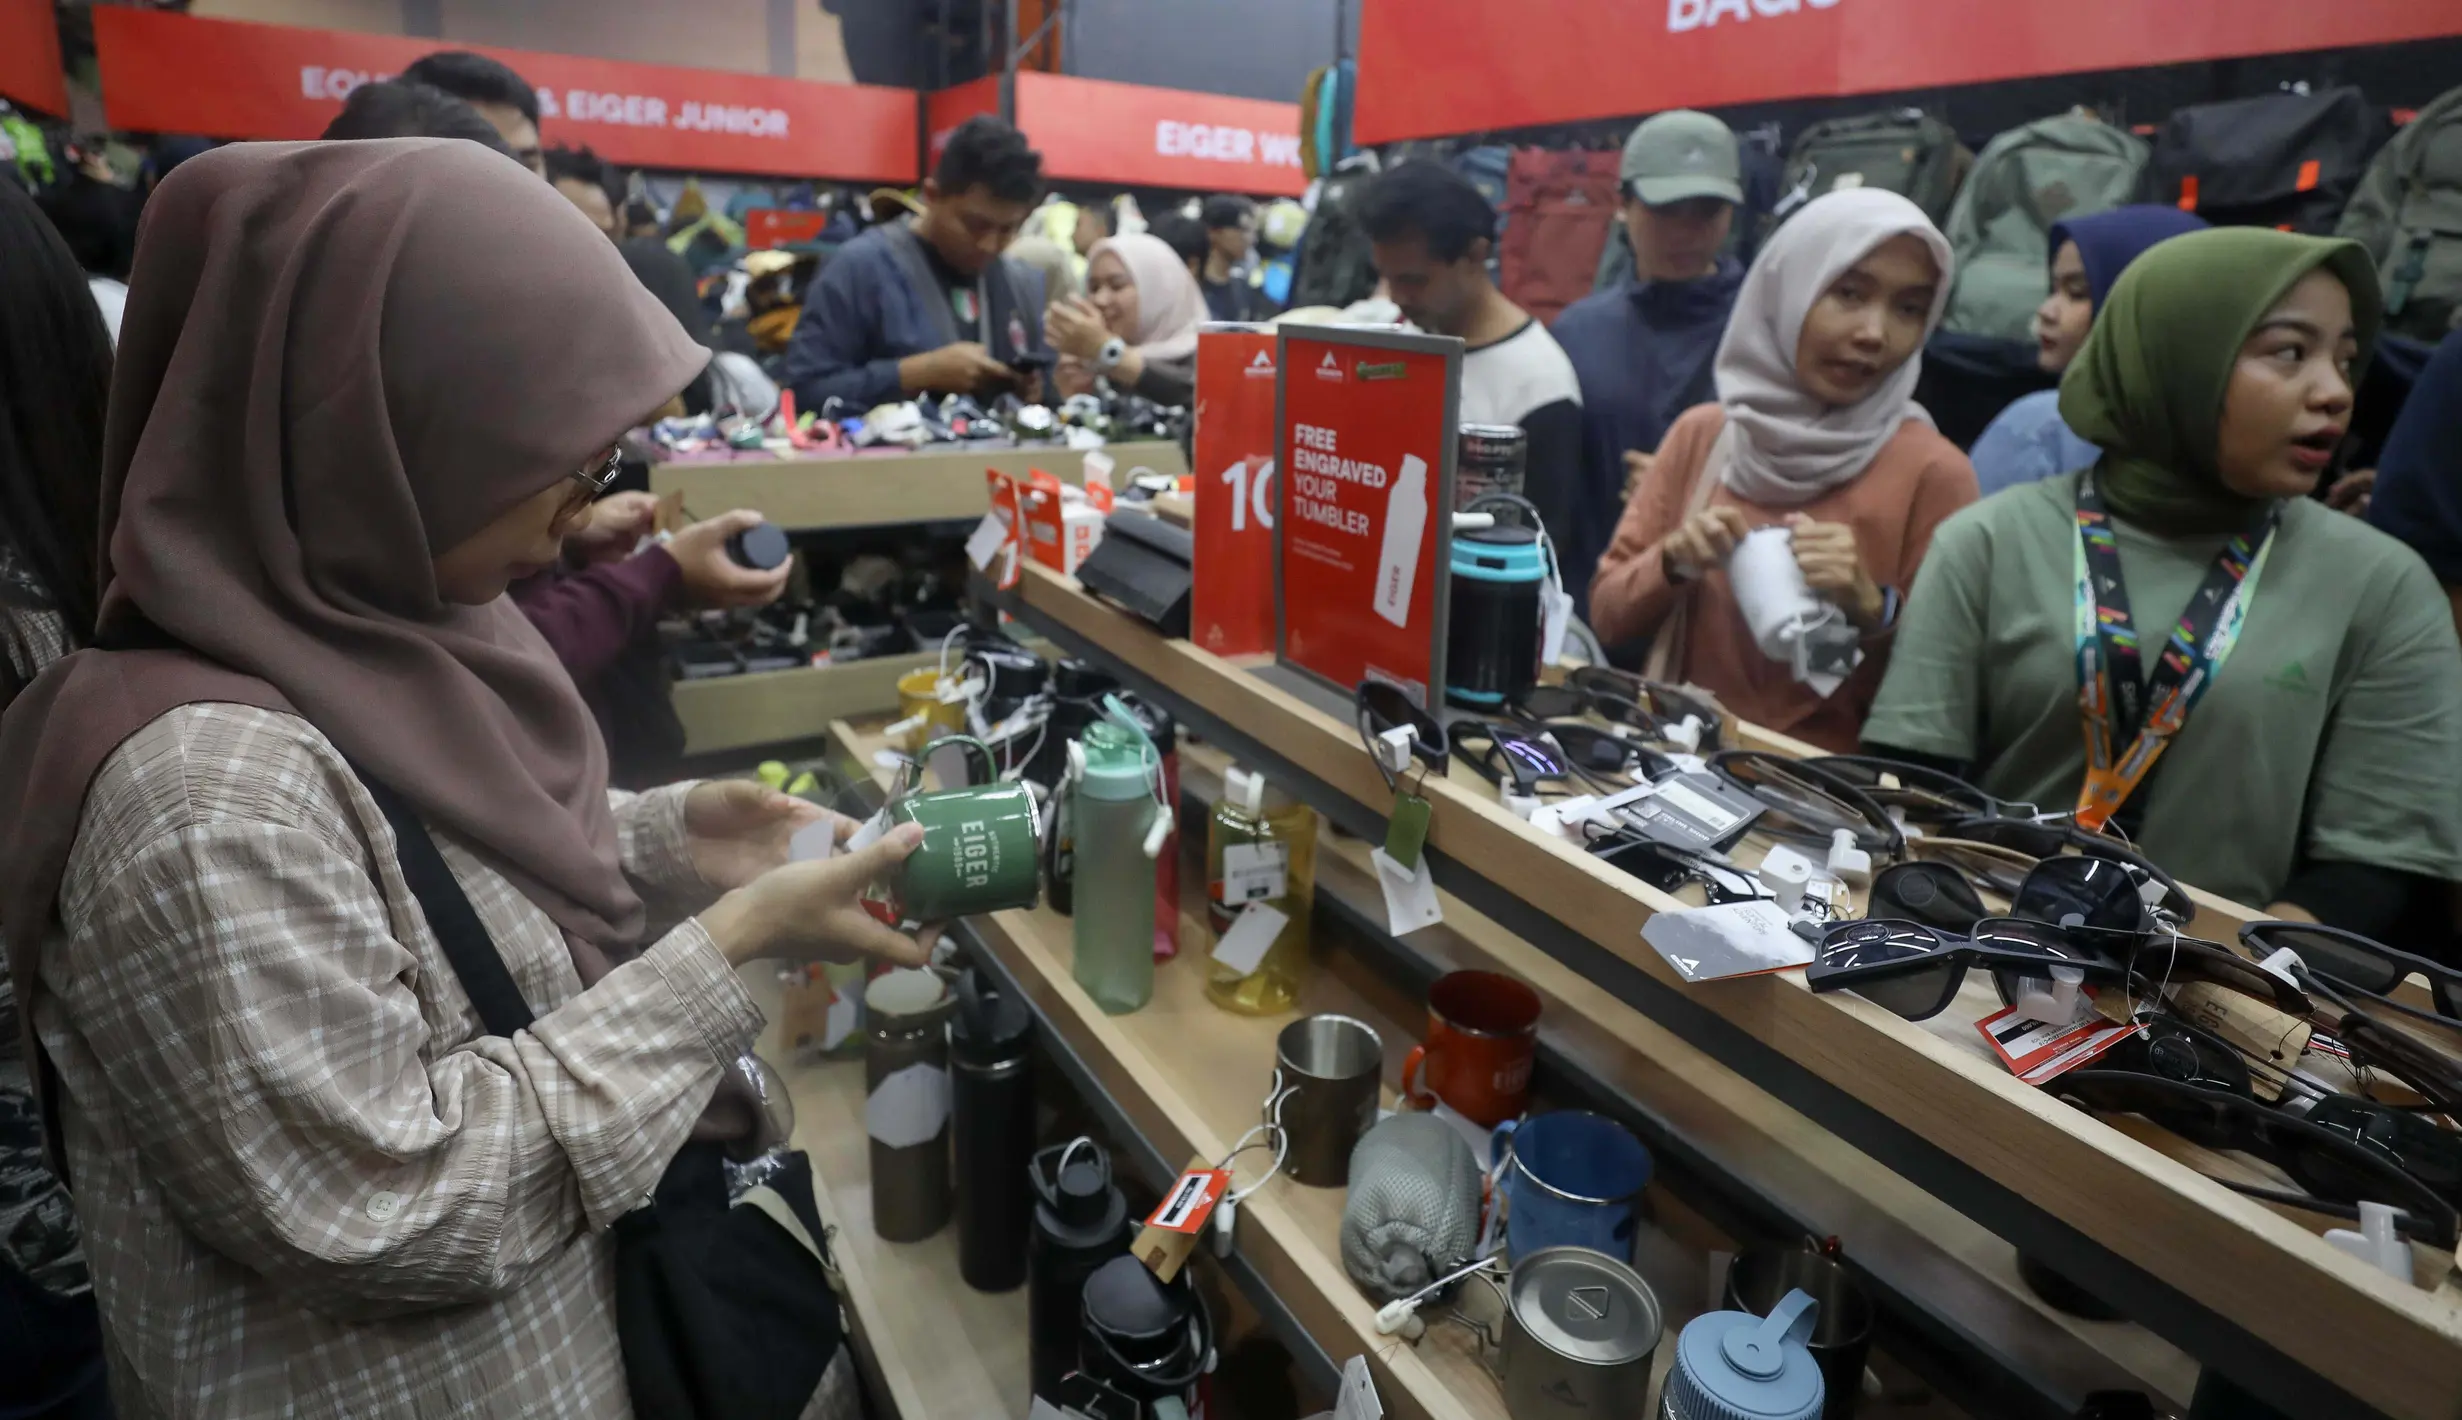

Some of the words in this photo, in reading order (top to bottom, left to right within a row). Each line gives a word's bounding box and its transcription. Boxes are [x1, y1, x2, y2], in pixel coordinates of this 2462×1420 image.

[566, 89, 668, 128] EIGER
[672, 100, 790, 139] JUNIOR
[1156, 119, 1255, 164] EIGER
[1294, 423, 1337, 451] FREE
[1293, 448, 1387, 488] ENGRAVED
[1293, 471, 1337, 503] YOUR
[1293, 496, 1370, 537] TUMBLER
[1388, 565, 1400, 607] EIGER
[961, 820, 989, 888] EIGER
